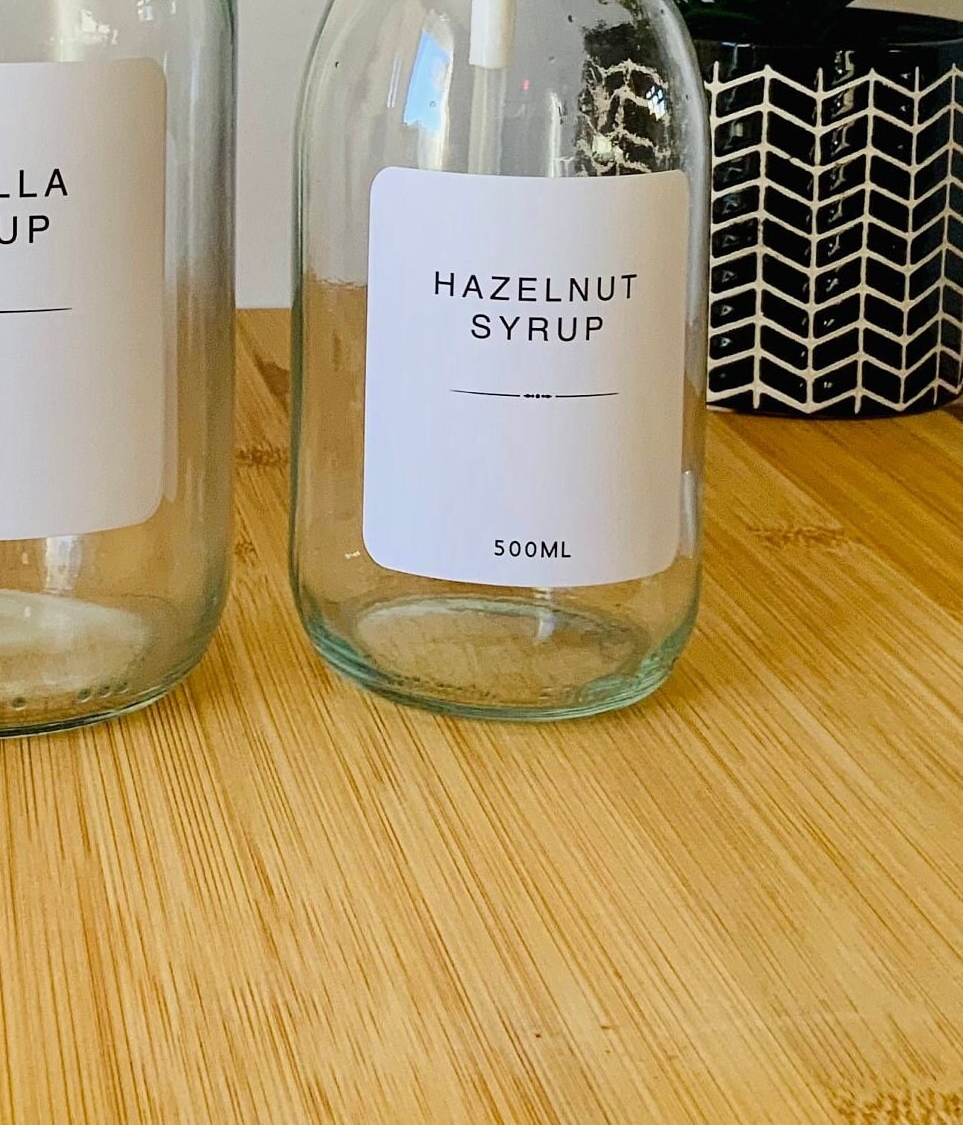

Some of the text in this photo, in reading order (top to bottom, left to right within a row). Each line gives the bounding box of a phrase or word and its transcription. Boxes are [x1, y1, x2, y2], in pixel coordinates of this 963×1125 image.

[434, 270, 637, 302] HAZELNUT
[470, 313, 603, 342] SYRUP
[493, 539, 571, 558] 500ML
